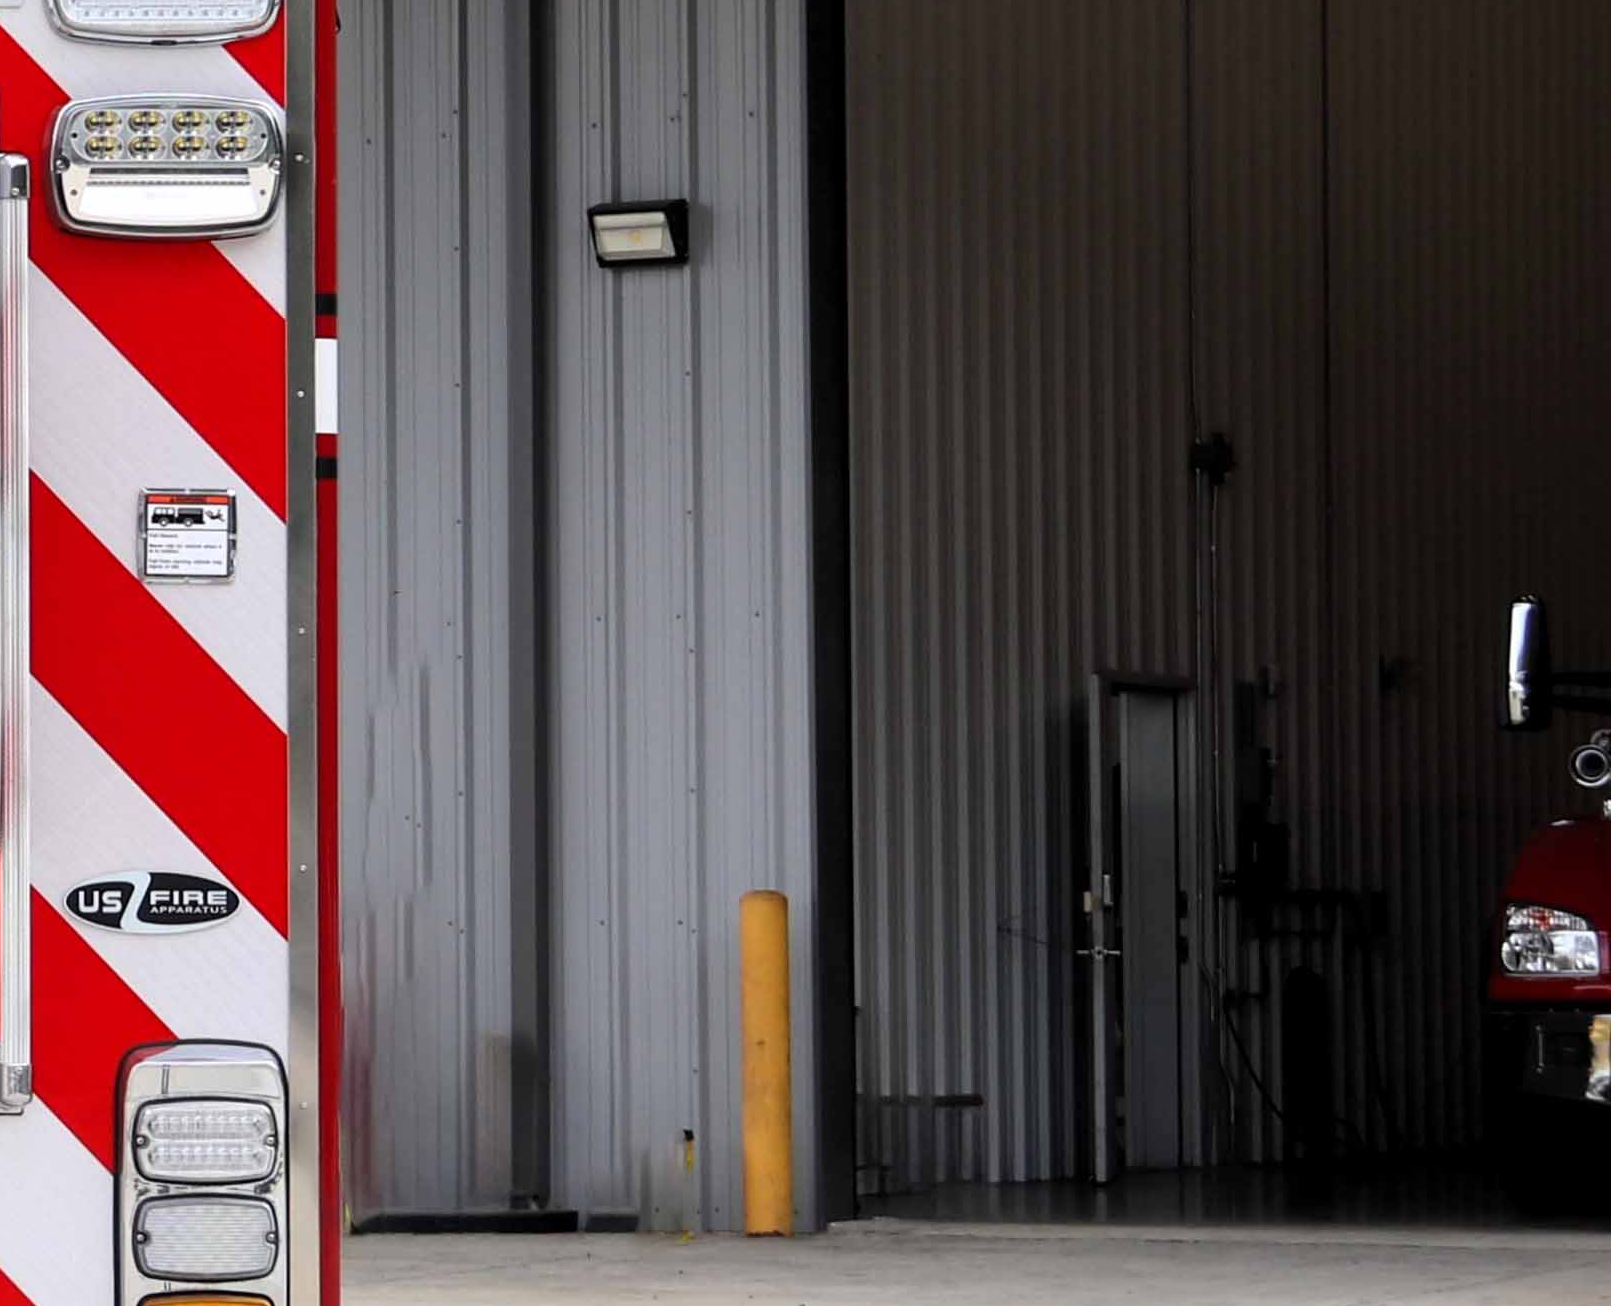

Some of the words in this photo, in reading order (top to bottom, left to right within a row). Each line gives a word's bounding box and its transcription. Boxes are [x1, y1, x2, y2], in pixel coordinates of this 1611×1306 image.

[78, 890, 123, 914] US
[149, 890, 228, 906] FIRE
[149, 906, 228, 915] APPARATUS
